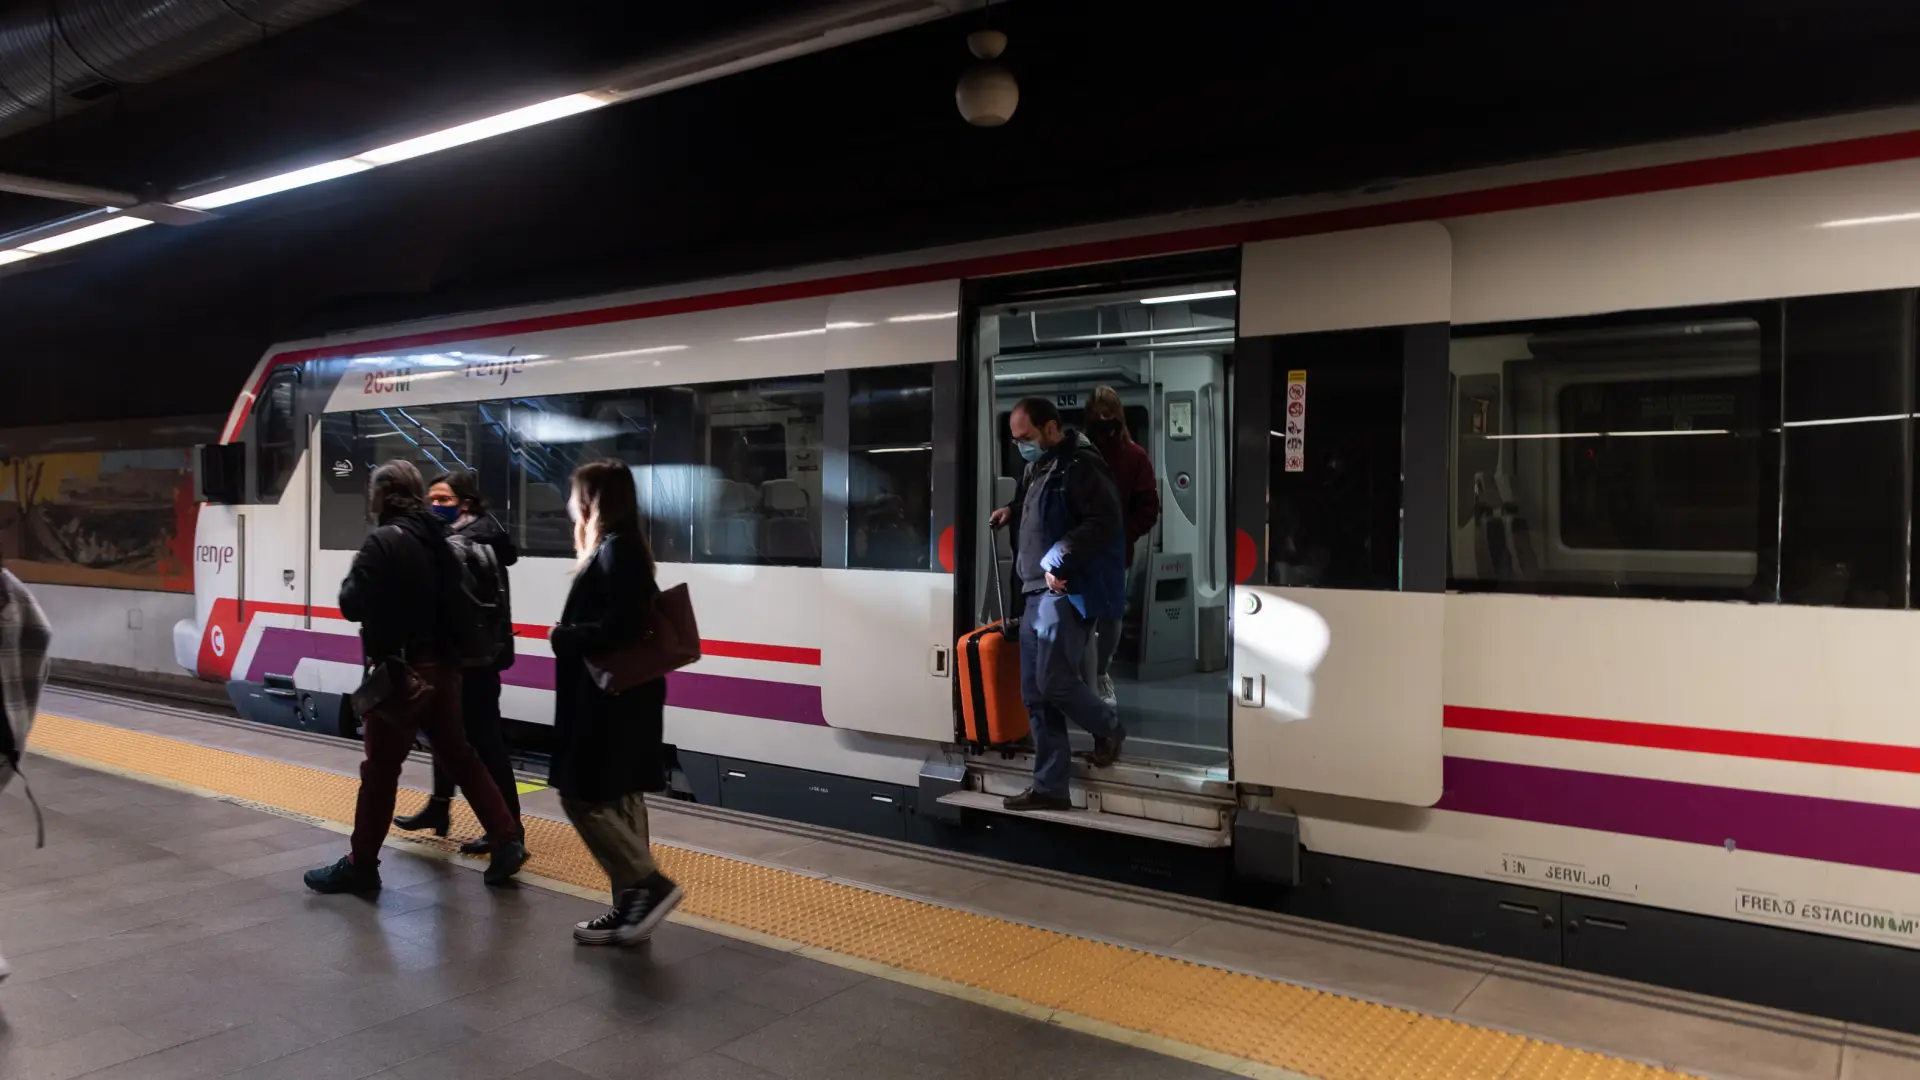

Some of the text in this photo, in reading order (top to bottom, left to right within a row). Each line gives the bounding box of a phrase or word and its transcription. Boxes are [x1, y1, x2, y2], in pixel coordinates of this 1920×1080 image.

[196, 545, 234, 575] renfe
[1741, 894, 1920, 934] FRENO ESTACIONAM
